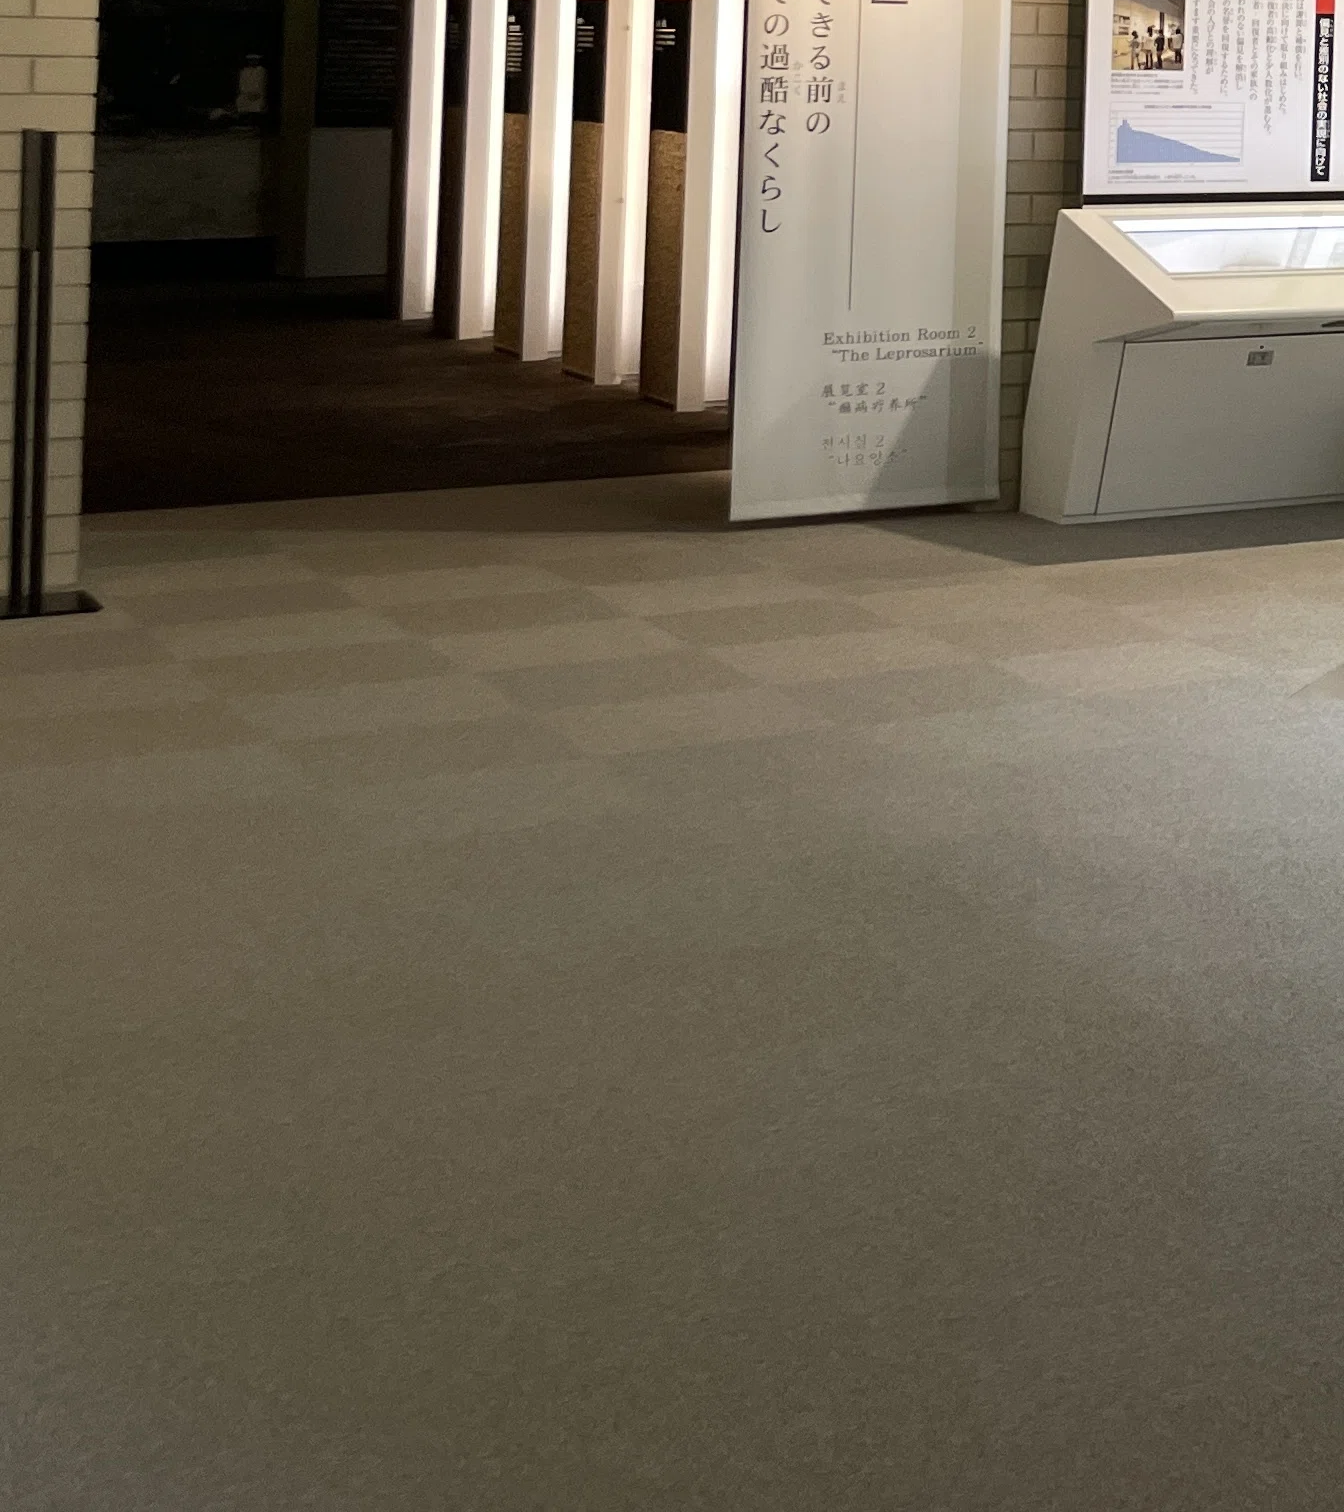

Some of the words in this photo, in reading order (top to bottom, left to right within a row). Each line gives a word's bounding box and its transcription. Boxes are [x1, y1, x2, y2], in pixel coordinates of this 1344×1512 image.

[822, 328, 911, 347] Exhibition
[918, 327, 961, 342] Room
[967, 326, 977, 339] 2
